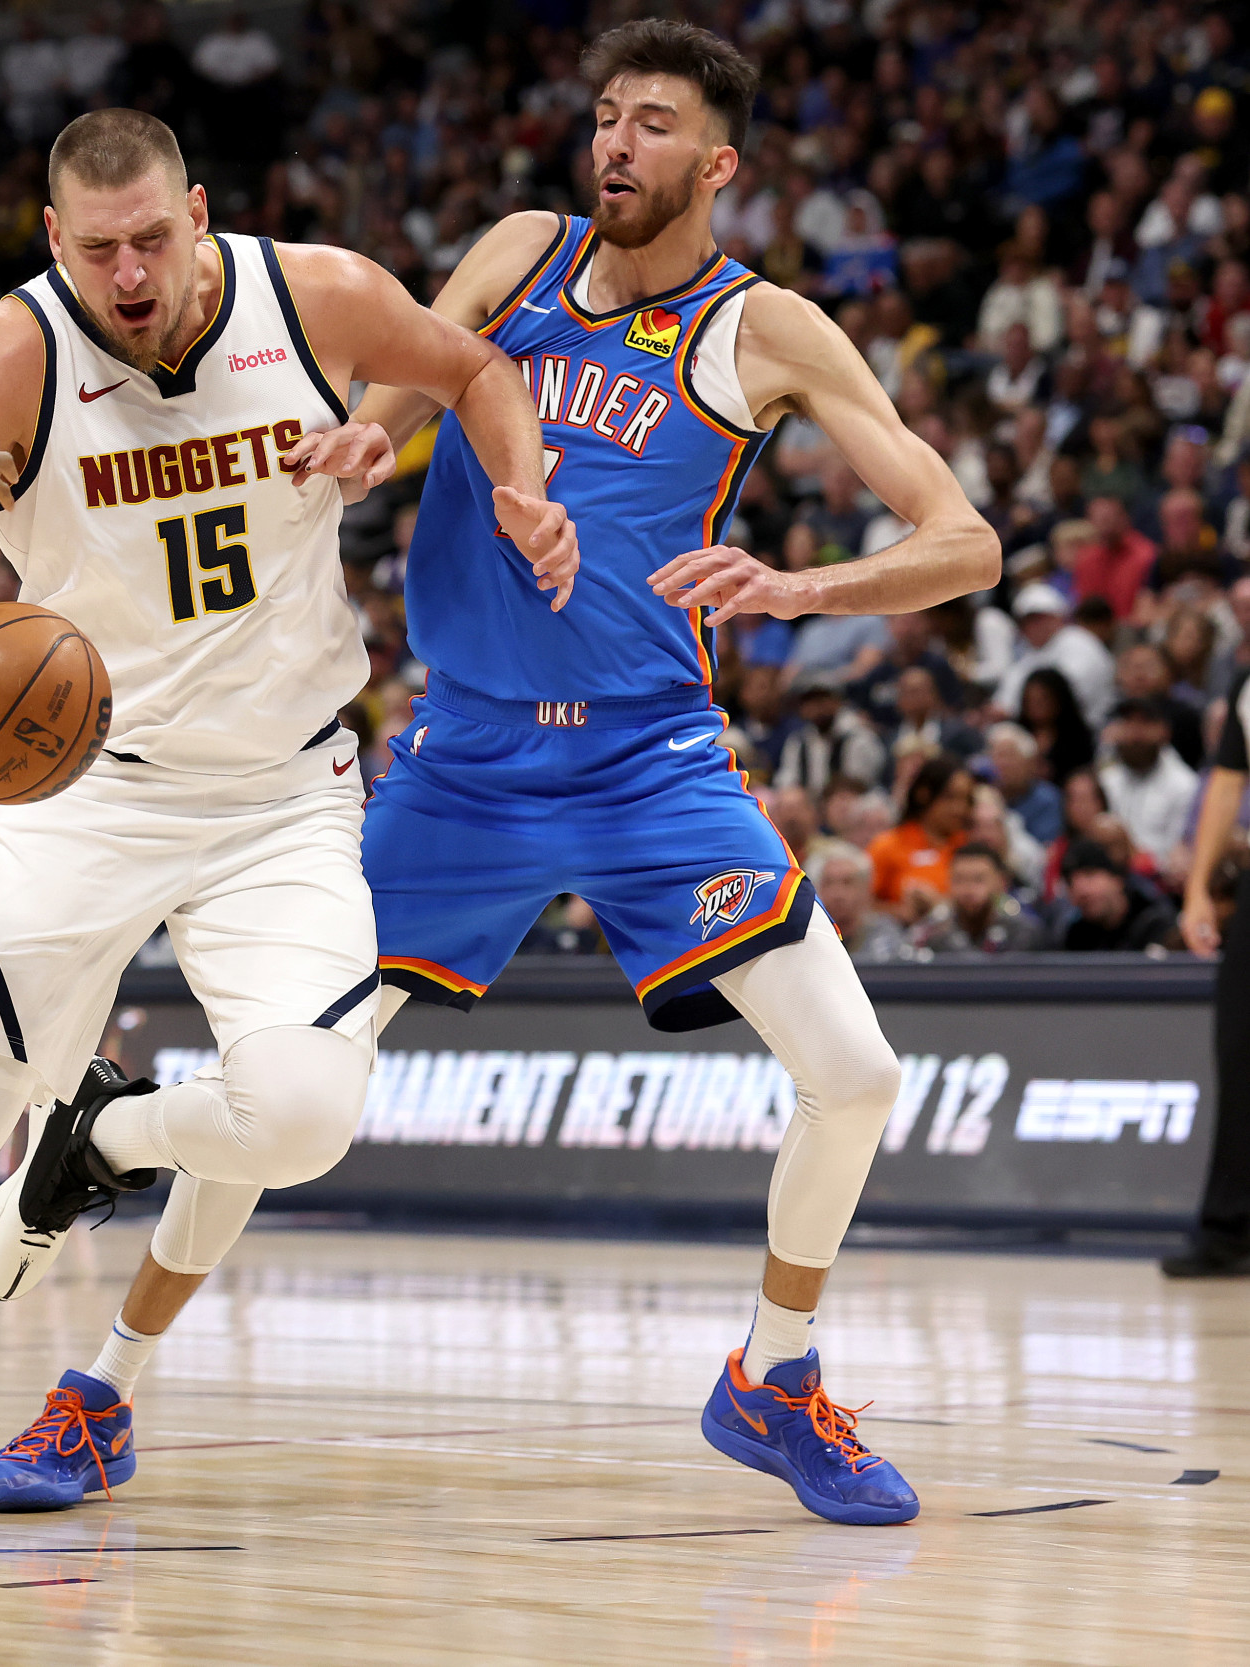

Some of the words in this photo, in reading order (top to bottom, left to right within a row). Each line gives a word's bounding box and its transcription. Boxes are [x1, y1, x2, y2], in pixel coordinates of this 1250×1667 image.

[227, 348, 288, 373] ibotta
[511, 353, 672, 458] NDER
[77, 418, 305, 509] NUGGETS
[155, 502, 260, 624] 15
[703, 876, 743, 925] OKC
[925, 1051, 1010, 1156] 12
[1014, 1079, 1200, 1143] ESPN
